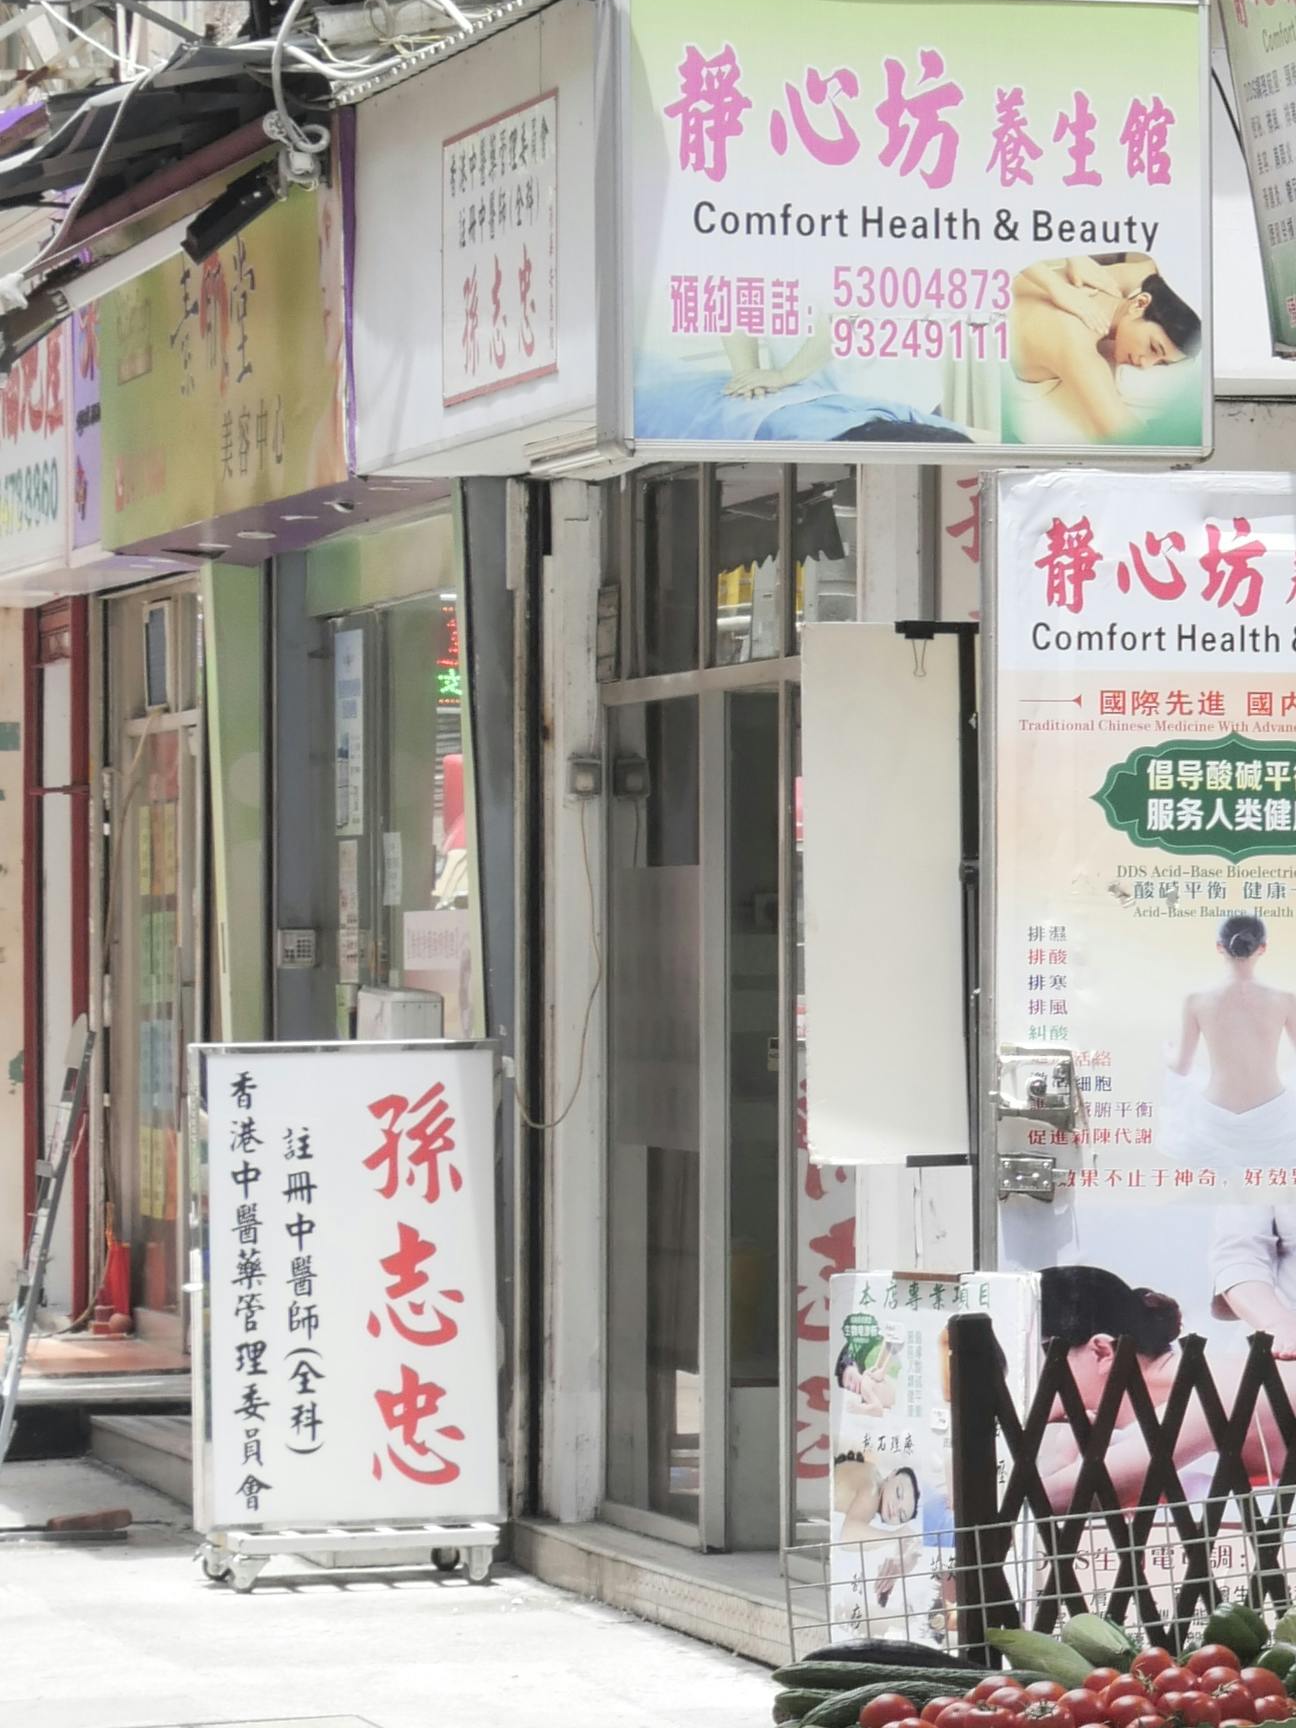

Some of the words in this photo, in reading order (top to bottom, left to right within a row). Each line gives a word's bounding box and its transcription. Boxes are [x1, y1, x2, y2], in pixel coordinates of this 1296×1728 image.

[692, 200, 849, 238] Comfort
[860, 205, 982, 242] Health
[993, 209, 1020, 242] &
[1032, 209, 1160, 252] Beauty
[832, 266, 1012, 311] 53004873
[832, 317, 1011, 360] 93249111
[1031, 622, 1167, 653] Comfort
[1177, 623, 1281, 654] Health
[1100, 689, 1226, 716] 國際先進
[1018, 719, 1094, 732] Traditional
[1098, 719, 1151, 732] Chinese
[1155, 720, 1215, 733] Medicine
[1218, 720, 1249, 733] With
[1117, 865, 1148, 878] DDS
[1254, 907, 1293, 919] Health
[1027, 948, 1068, 965] 排酸
[1027, 974, 1068, 991] 排寒
[1027, 999, 1068, 1016] 排風
[362, 1080, 466, 1486] 孫志忠
